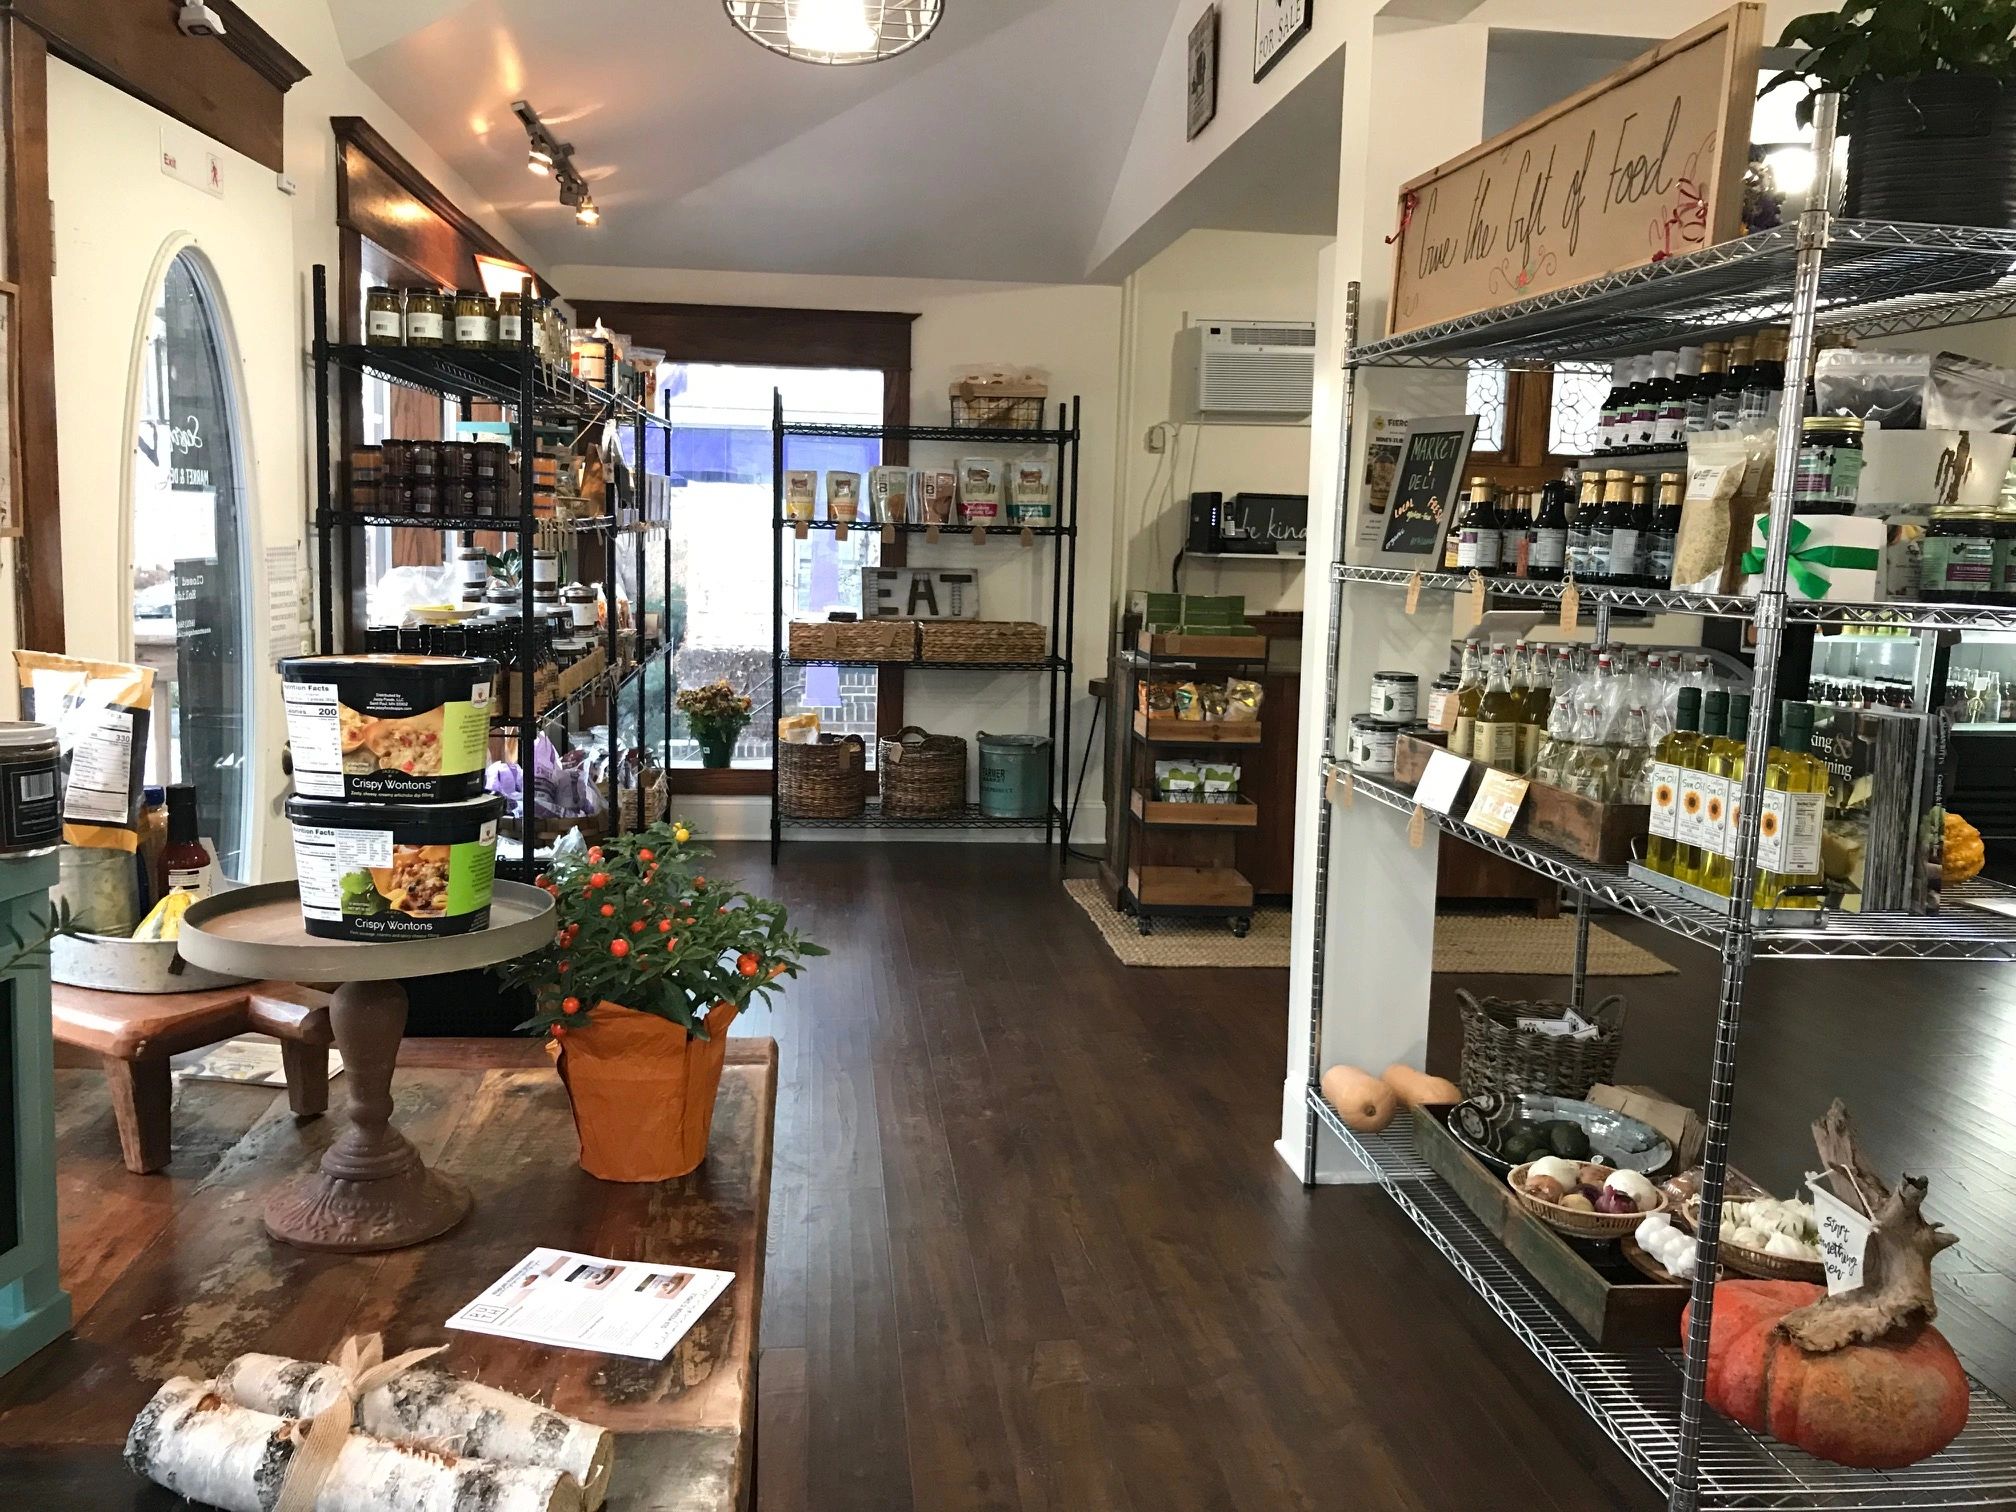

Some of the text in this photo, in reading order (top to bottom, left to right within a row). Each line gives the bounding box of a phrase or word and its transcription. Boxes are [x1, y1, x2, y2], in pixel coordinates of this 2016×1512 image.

[1259, 0, 1300, 64] FOR SALE
[163, 152, 177, 170] Exit
[1562, 129, 1595, 257] of
[1603, 96, 1682, 213] Food
[1408, 474, 1436, 490] DELI
[870, 570, 972, 617] EAT
[318, 708, 337, 716] 200
[115, 734, 130, 743] 330
[352, 777, 432, 791] Crispy Wontons
[355, 918, 433, 931] Crispy Wontons
